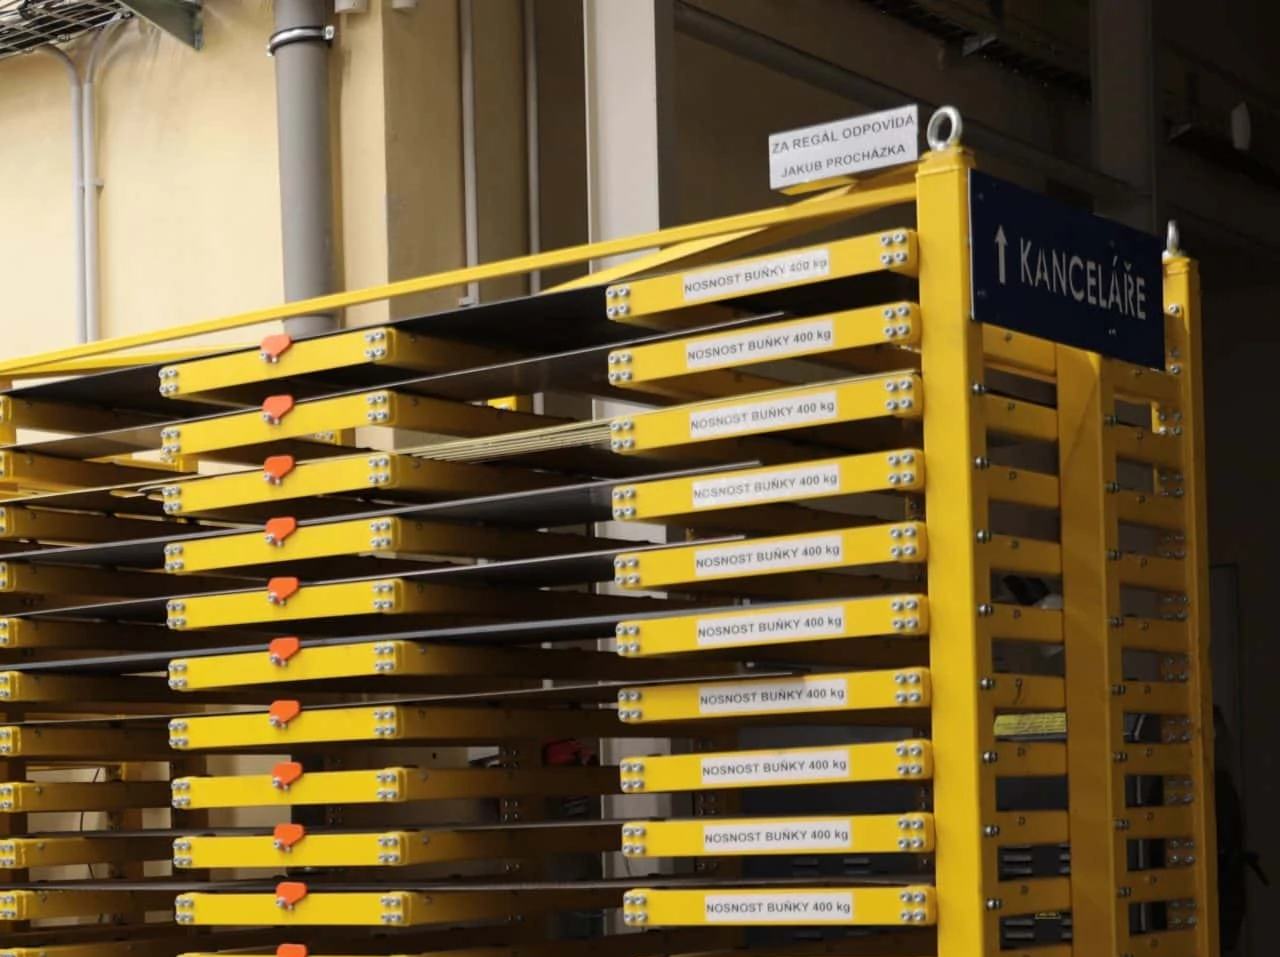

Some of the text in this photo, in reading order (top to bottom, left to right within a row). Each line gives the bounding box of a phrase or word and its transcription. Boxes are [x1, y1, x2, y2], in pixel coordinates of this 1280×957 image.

[772, 142, 789, 154] ZA
[792, 130, 839, 150] REGÁL
[781, 143, 906, 178] JAKUB PROCHÁZKA
[684, 273, 741, 294] NOSNOST
[790, 260, 810, 274] 400
[813, 259, 828, 271] kg
[1020, 236, 1147, 321] KANCELÁŘE
[687, 342, 744, 362] NOSNOST
[793, 331, 814, 344] 400
[817, 330, 831, 341] kg
[690, 412, 748, 431] NOSNOST
[797, 402, 817, 415] 400
[820, 402, 835, 413] kg
[693, 483, 751, 500] NOSNOST
[799, 474, 820, 487] 400
[823, 474, 838, 485] kg
[696, 553, 753, 569] NOSNOST
[802, 545, 822, 558] 400
[825, 545, 840, 557] kg
[698, 623, 755, 638] NOSNOST
[804, 617, 824, 629] 400
[827, 616, 842, 628] kg
[700, 692, 758, 706] NOSNOST
[806, 688, 827, 699] 400
[830, 687, 844, 699] kg
[702, 763, 760, 776] NOSNOST
[808, 760, 829, 771] 400
[832, 760, 847, 772] kg
[704, 832, 762, 844] NOSNOST
[811, 830, 831, 840] 400
[834, 830, 849, 842] kg
[706, 903, 764, 914] NOSNOST
[812, 902, 833, 912] 400
[836, 902, 850, 914] kg
